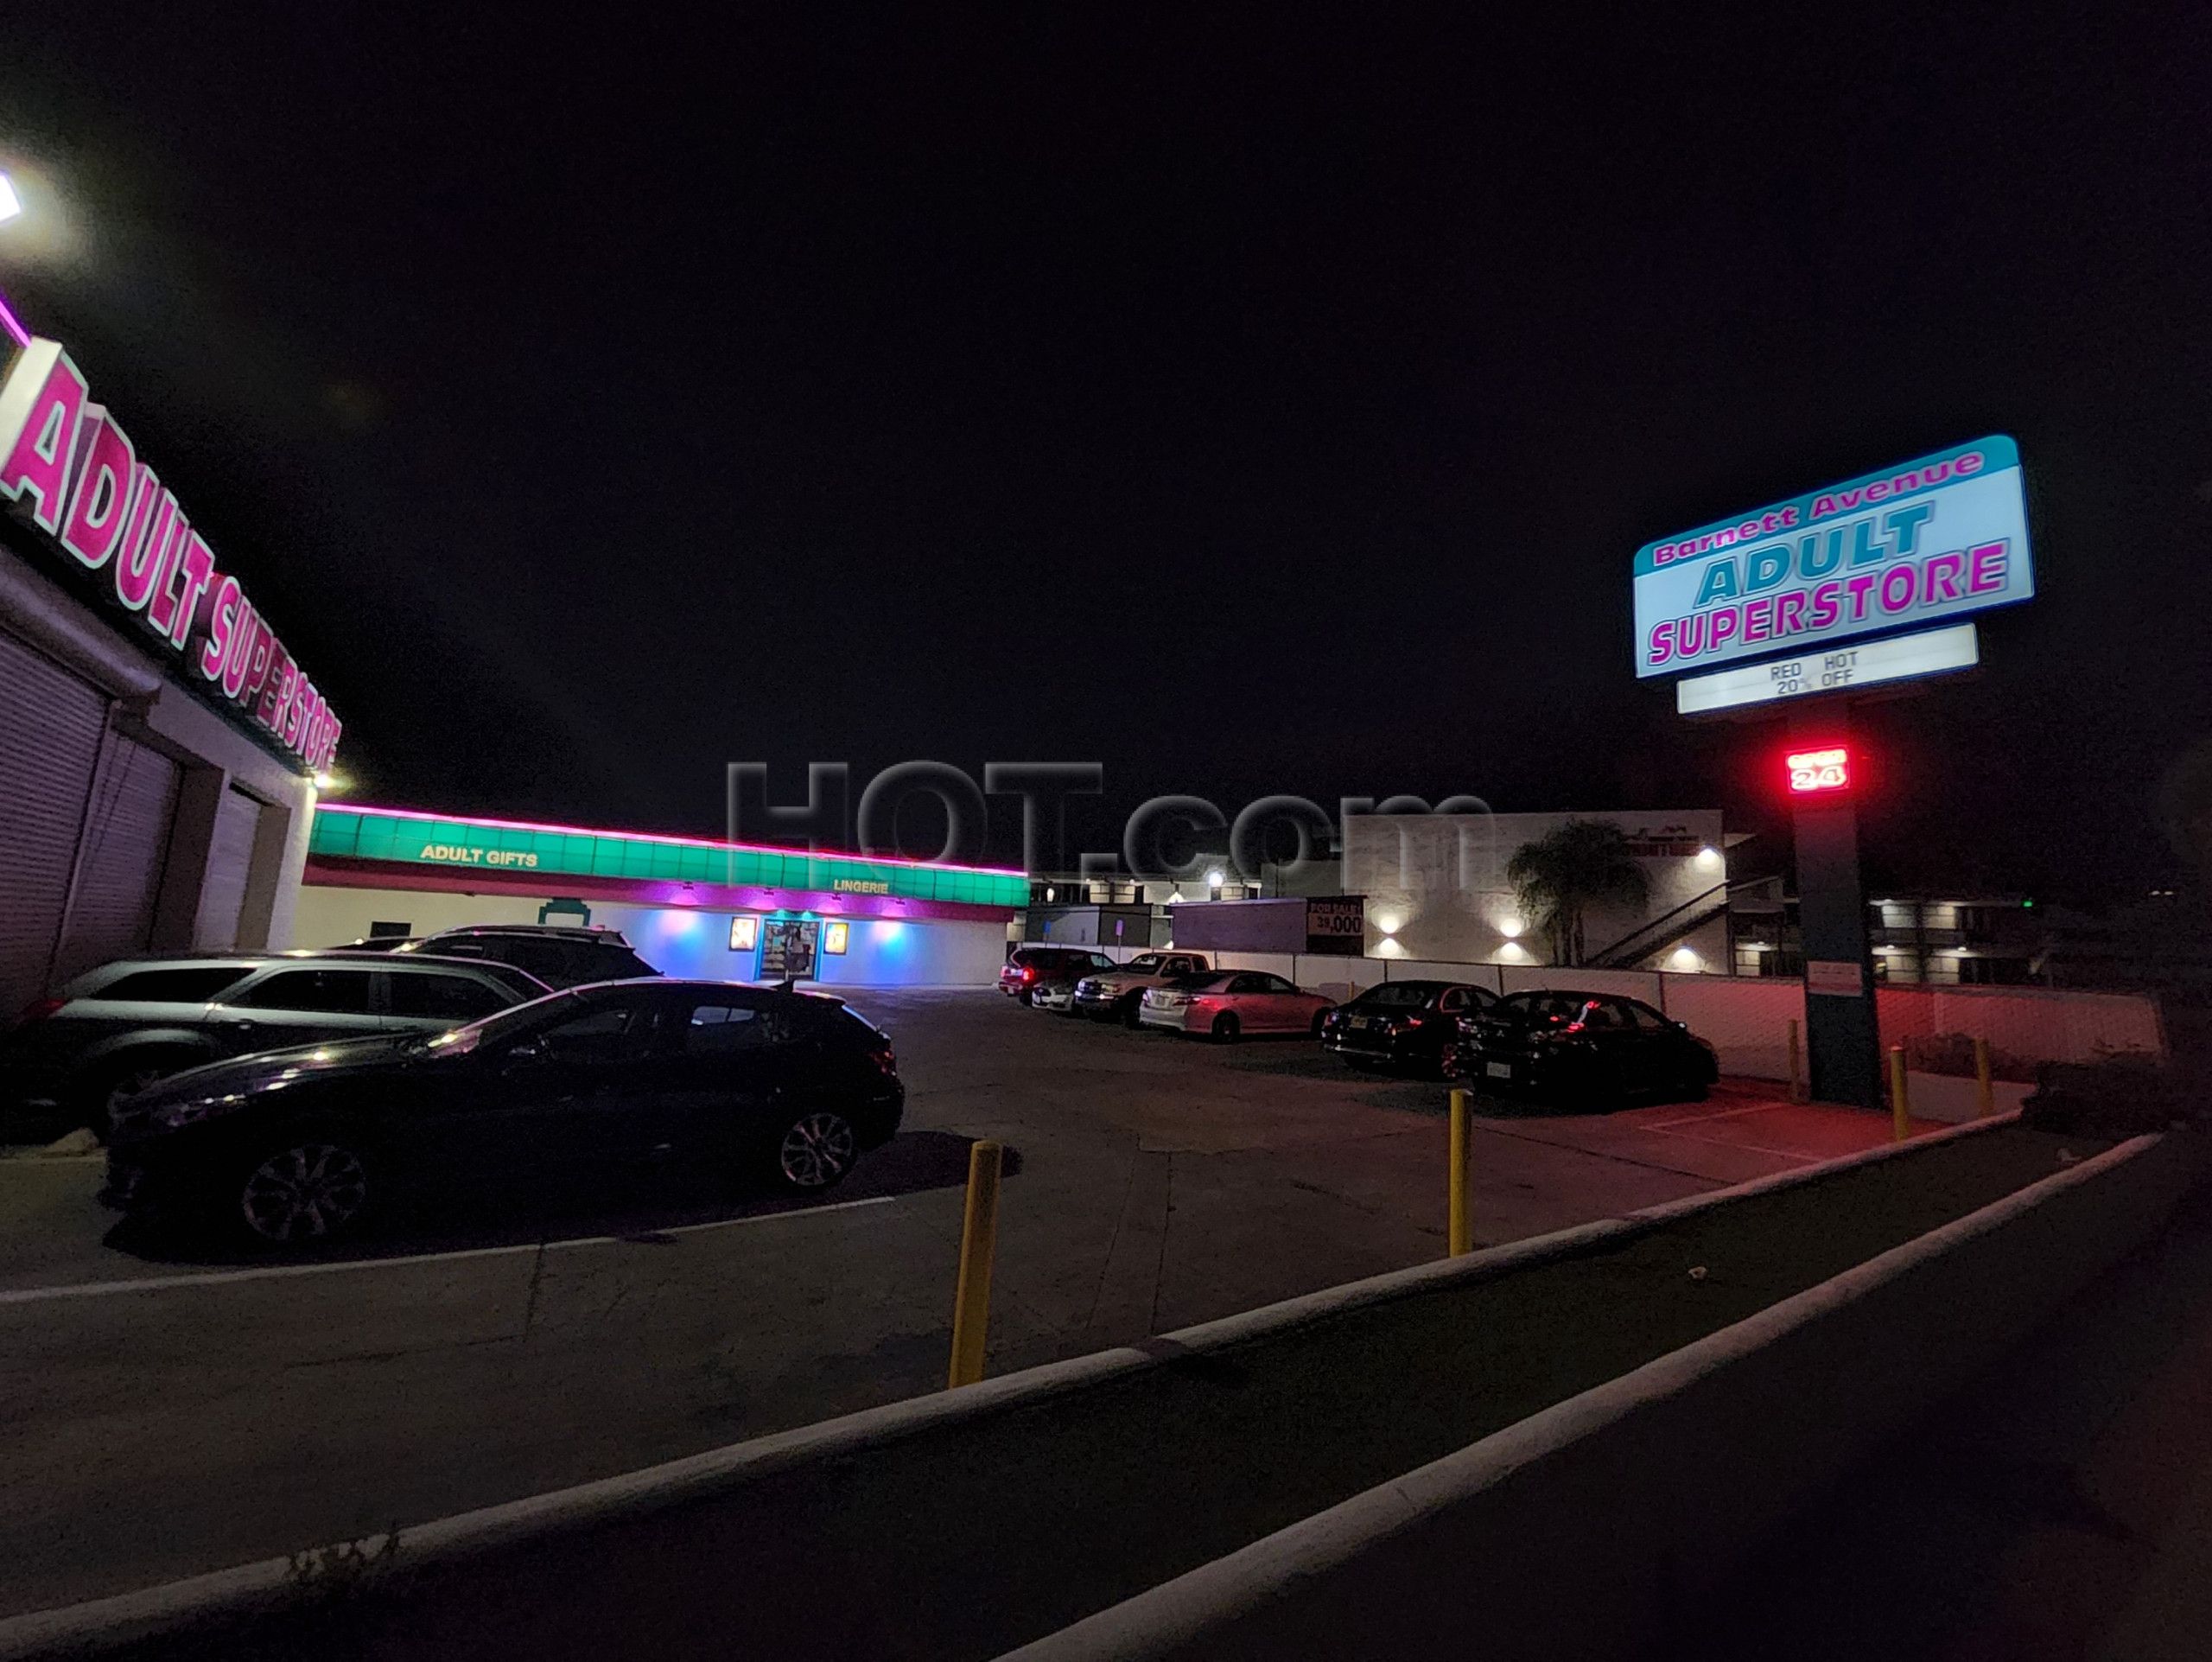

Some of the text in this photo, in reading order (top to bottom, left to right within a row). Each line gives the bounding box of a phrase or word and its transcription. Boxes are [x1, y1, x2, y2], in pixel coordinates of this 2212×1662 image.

[1653, 451, 1985, 567] Barnett Avenue
[0, 348, 342, 771] ADULT SUPERSTORE
[1693, 500, 1936, 609] ADULT
[1646, 538, 2010, 667] SUPERSTORE
[1771, 651, 1858, 680] RED HOT
[1821, 669, 1853, 686] OFF
[420, 844, 537, 867] ADULT GIFTS
[834, 878, 888, 894] LINGERIE
[1310, 902, 1332, 914] FOR
